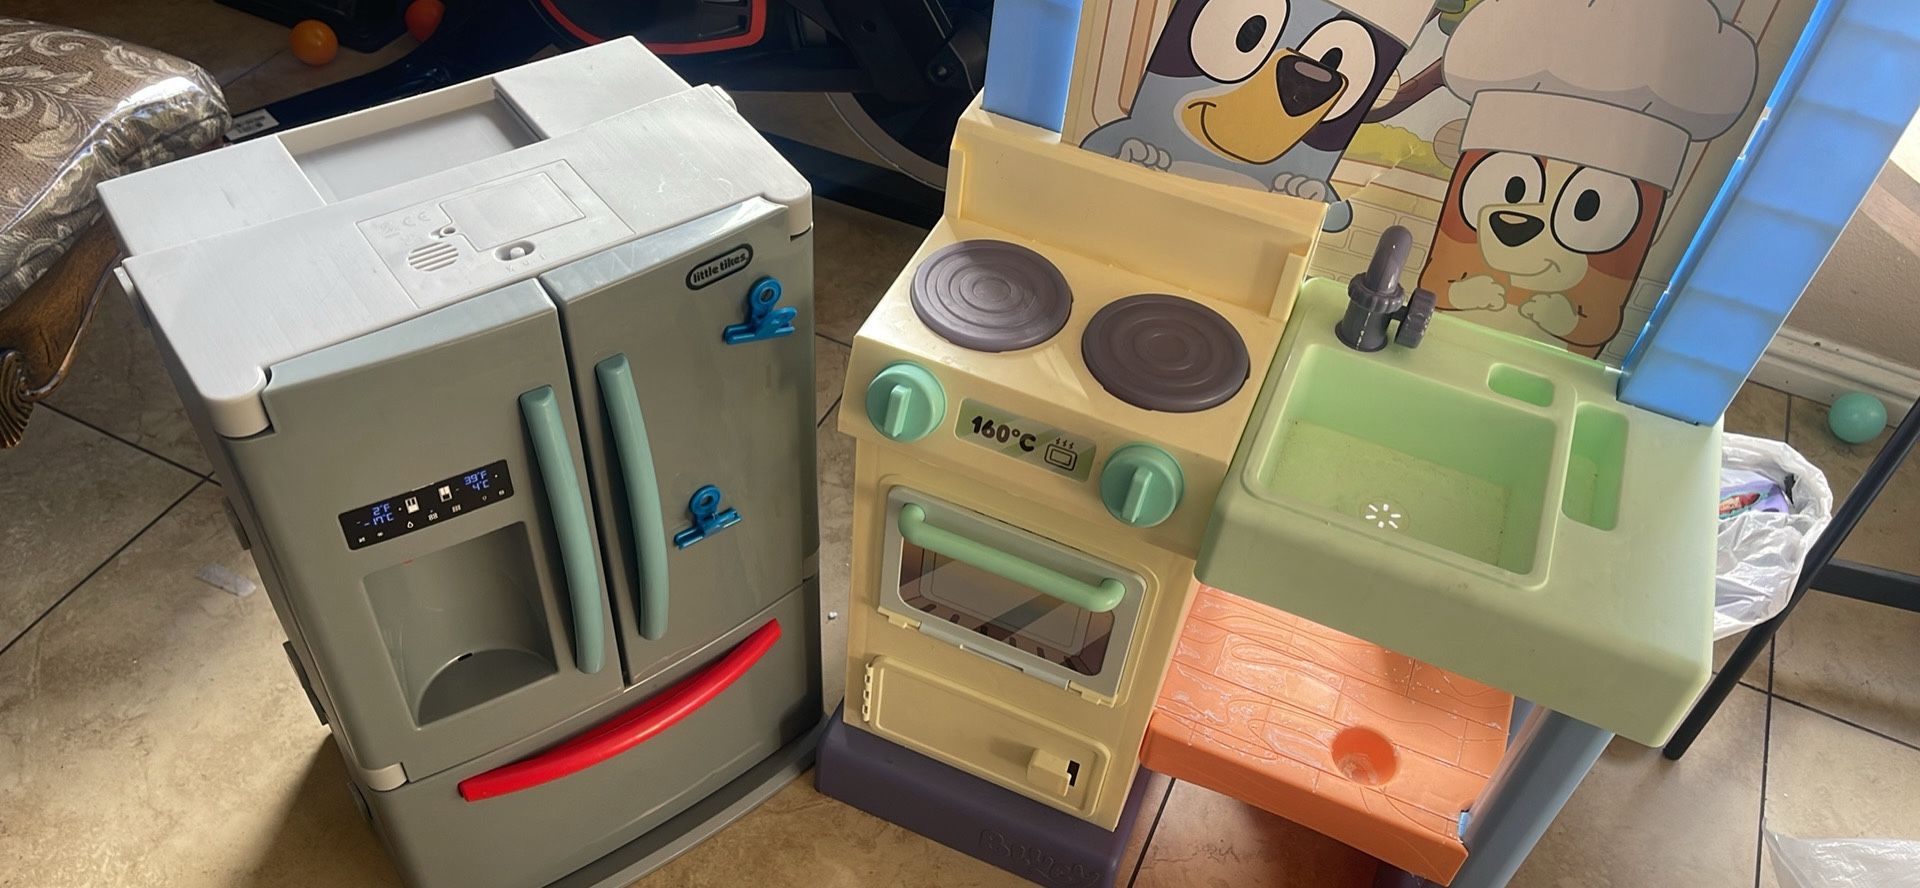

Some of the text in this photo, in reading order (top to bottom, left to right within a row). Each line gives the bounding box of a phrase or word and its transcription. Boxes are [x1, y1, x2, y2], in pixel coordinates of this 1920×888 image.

[693, 252, 746, 283] little tikes
[971, 415, 1037, 452] 160°C
